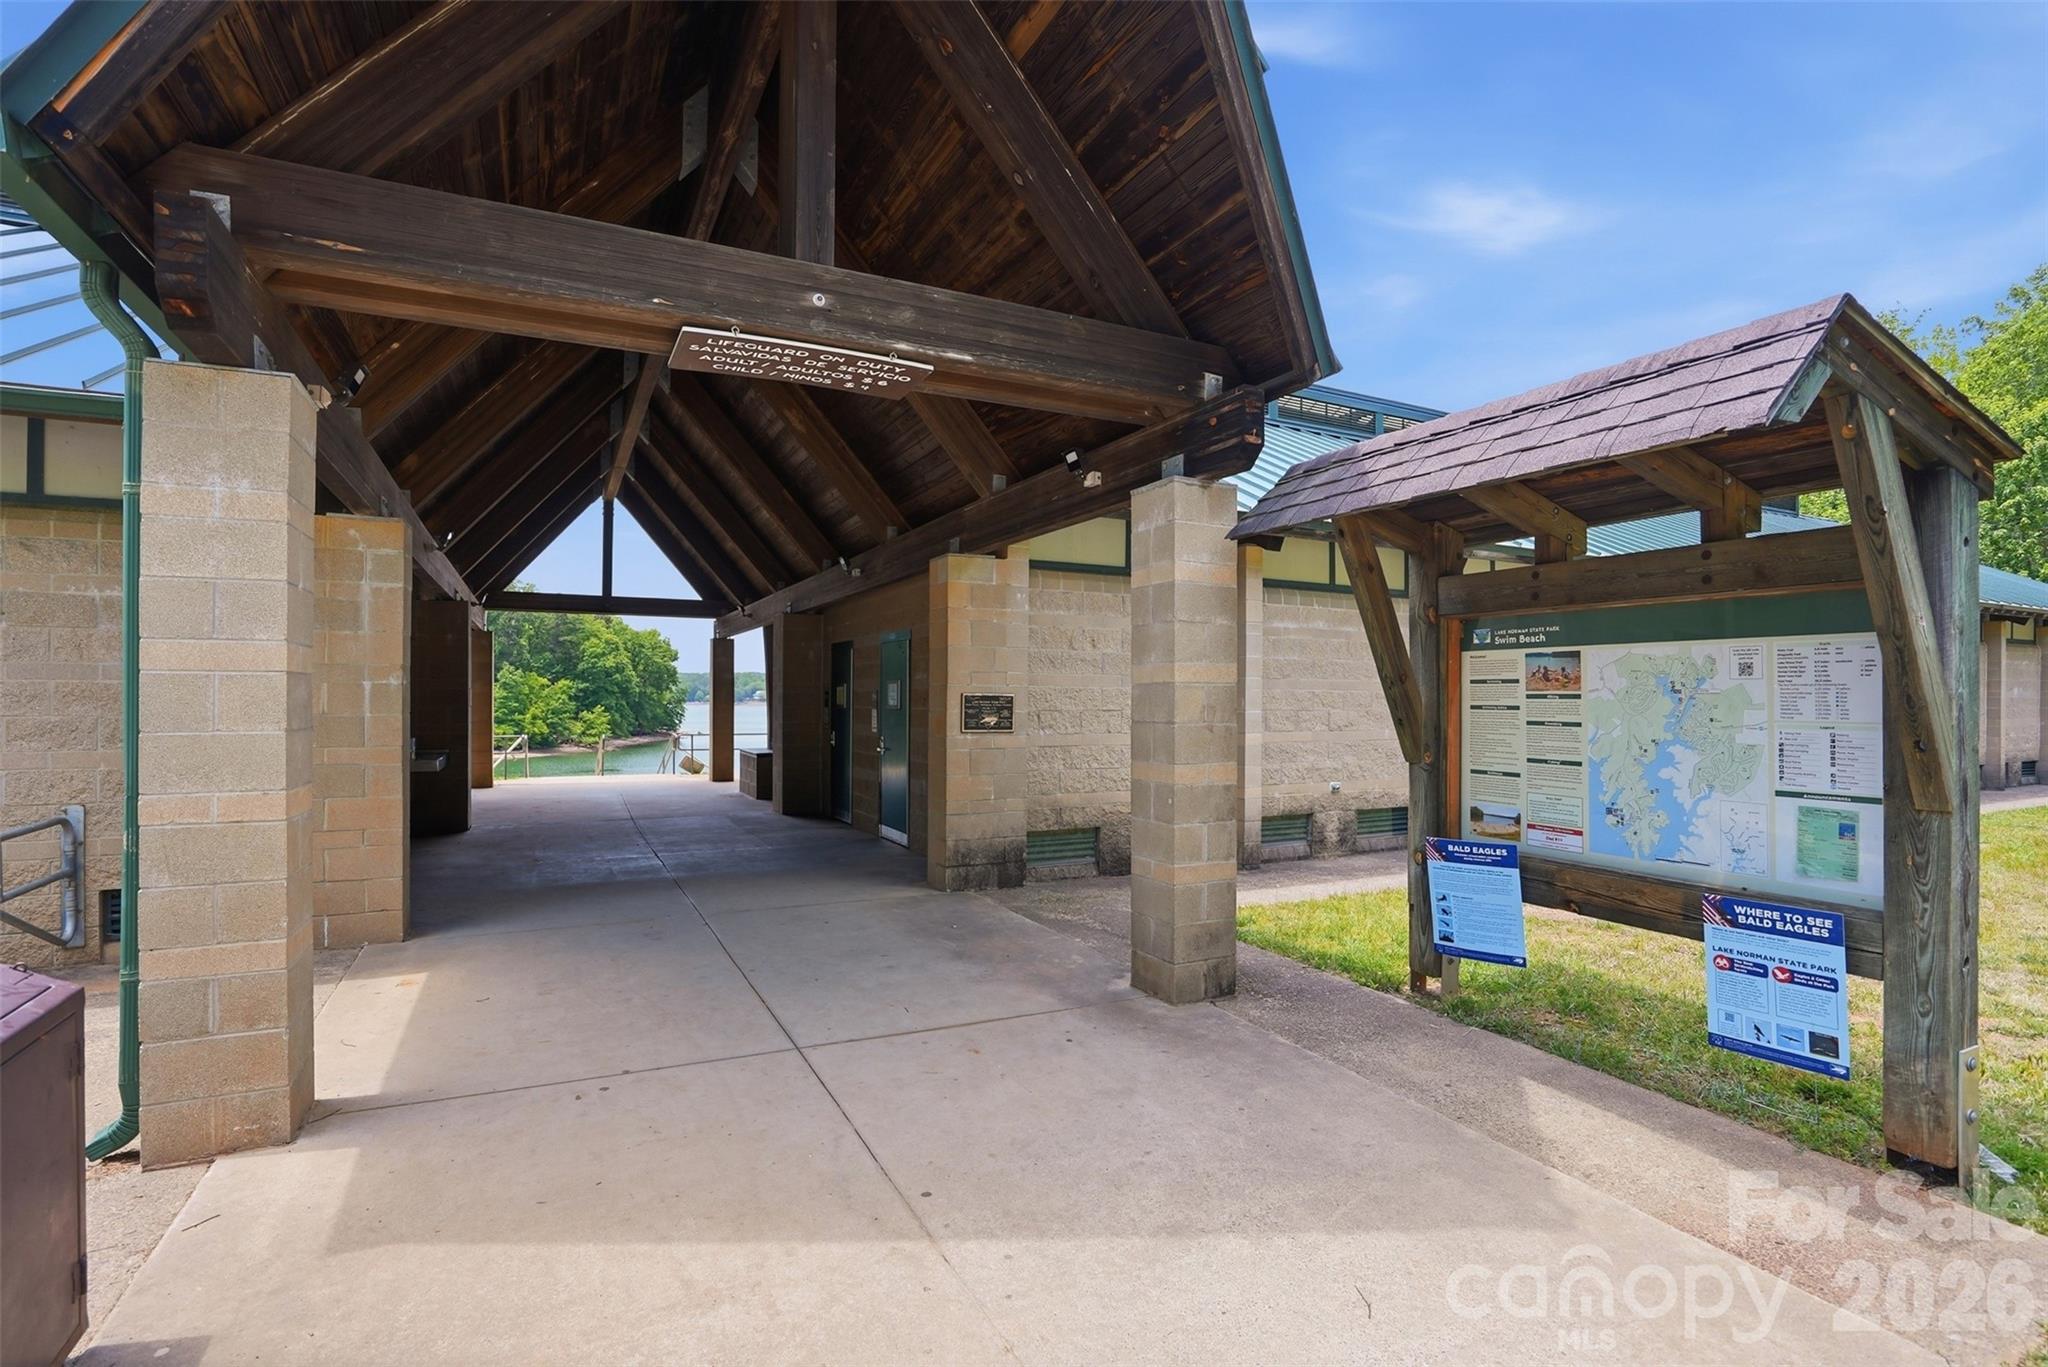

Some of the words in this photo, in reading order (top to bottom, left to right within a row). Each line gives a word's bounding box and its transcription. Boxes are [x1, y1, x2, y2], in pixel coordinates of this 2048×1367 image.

[689, 344, 792, 362] SALVAVIDAS
[804, 360, 828, 368] DE
[838, 365, 911, 382] SERVICIO
[699, 355, 759, 366] ADULT
[776, 364, 853, 380] ADULTOS
[707, 338, 809, 357] LIFEGUARD
[820, 354, 845, 363] ON
[857, 360, 906, 373] DUTY
[712, 364, 763, 374] CHILD
[1494, 635, 1517, 645] Swim
[1519, 633, 1546, 643] Beach
[1447, 844, 1471, 853] BALD
[1472, 847, 1508, 856] EAGLES
[1734, 905, 1781, 920] WHERE
[1784, 913, 1803, 923] TO
[1807, 916, 1833, 929] SEE
[1738, 915, 1773, 928] BALD
[1776, 922, 1829, 938] EAGLES
[1712, 945, 1734, 955] LAKE
[1736, 948, 1776, 962] NORMAN
[1778, 957, 1808, 969] STATE
[1810, 963, 1837, 975] PARK
